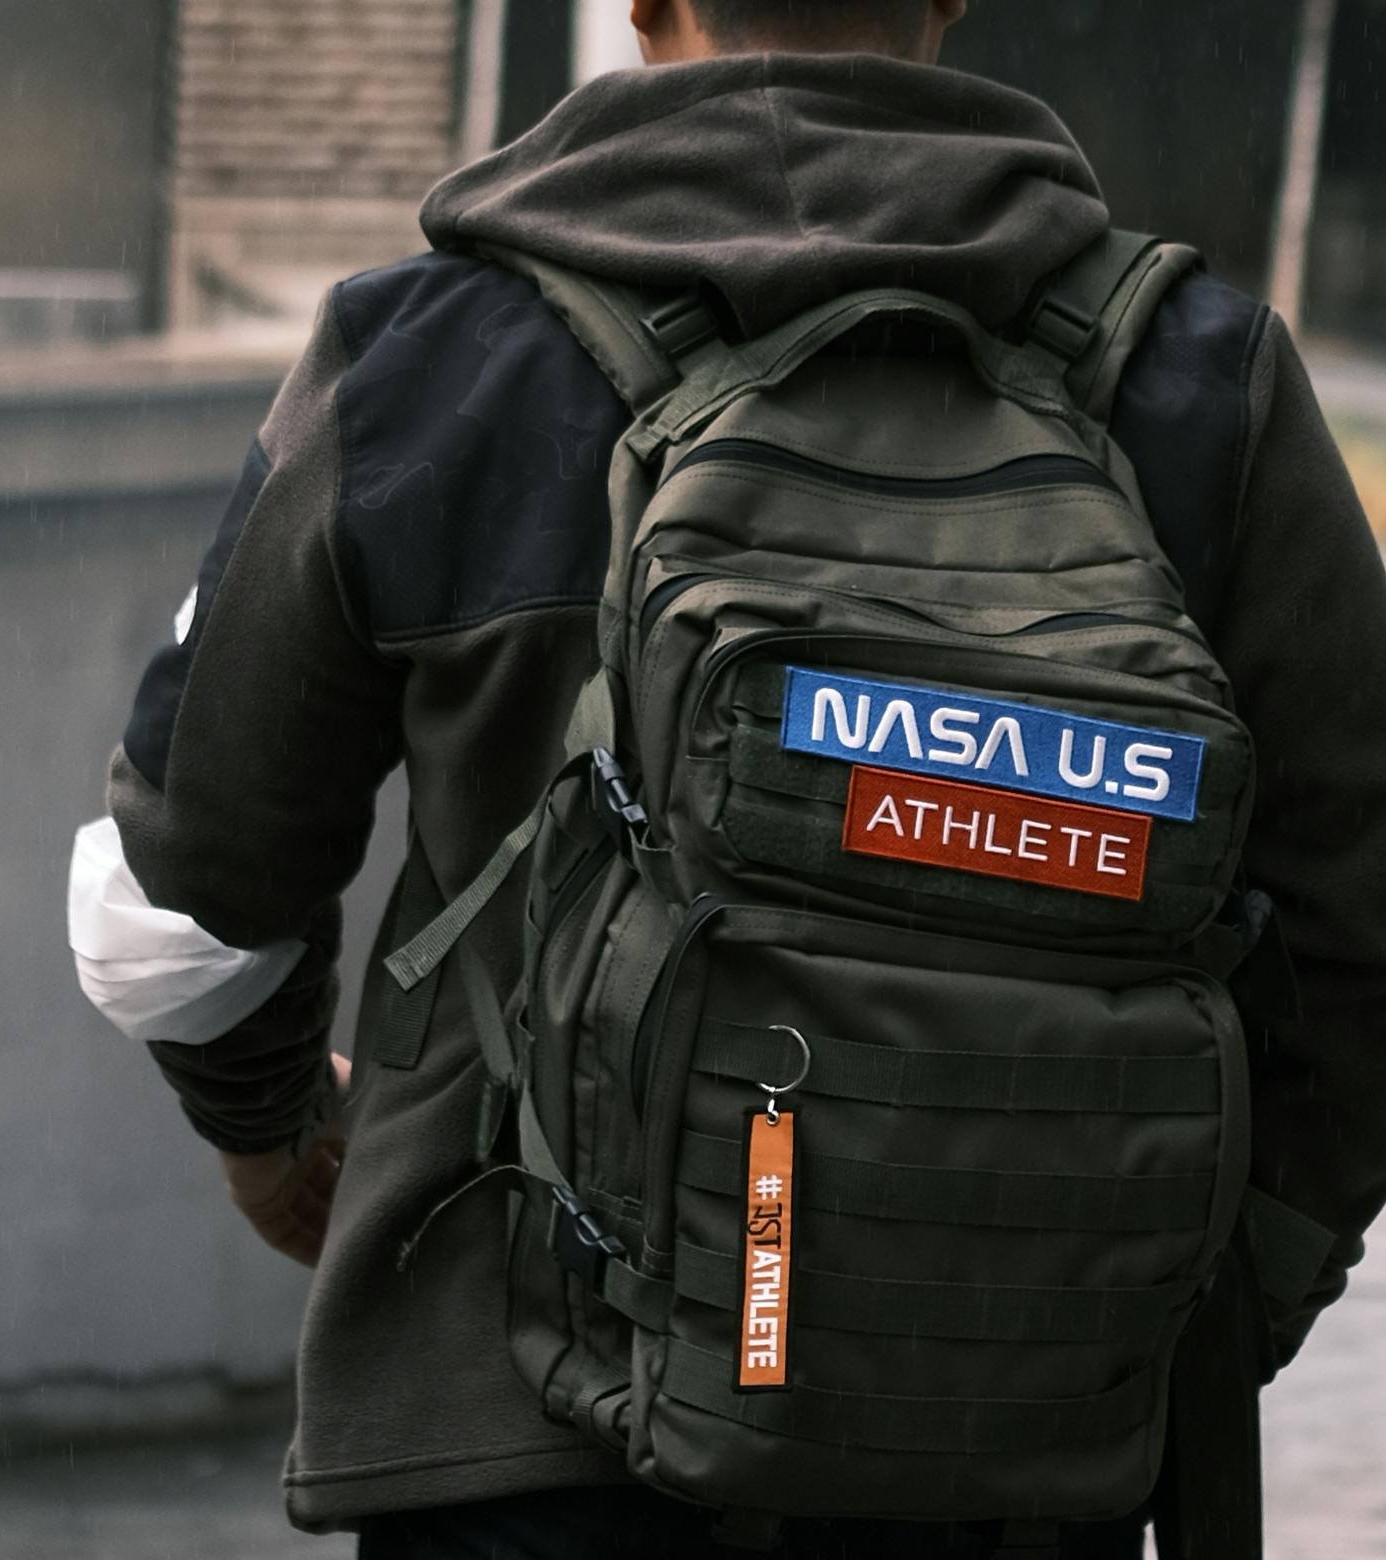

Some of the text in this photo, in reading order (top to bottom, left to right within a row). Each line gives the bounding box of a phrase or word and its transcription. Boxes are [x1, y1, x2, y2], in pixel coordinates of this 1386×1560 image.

[811, 687, 1173, 802] NASA U.S
[866, 794, 1131, 876] ATHLETE
